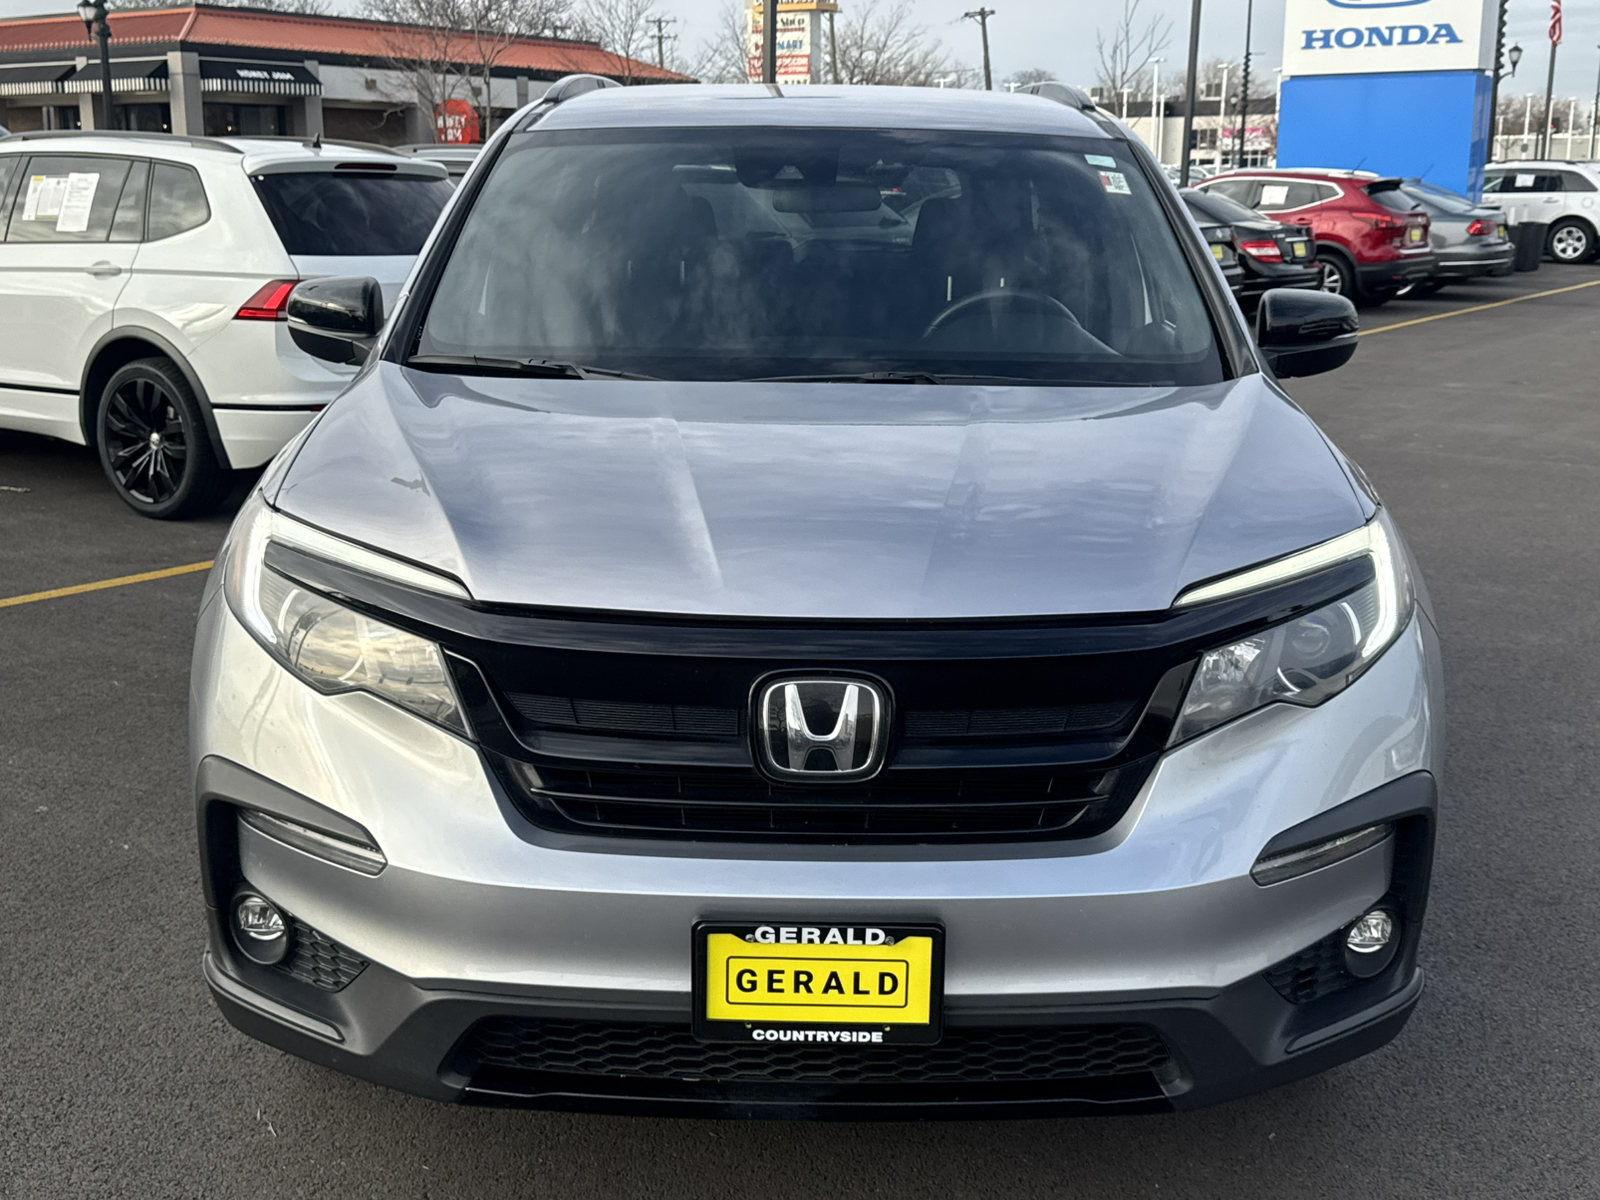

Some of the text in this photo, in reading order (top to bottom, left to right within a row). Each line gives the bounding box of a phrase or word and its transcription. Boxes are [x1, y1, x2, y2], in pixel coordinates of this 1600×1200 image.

[1301, 23, 1463, 50] HONDA
[754, 926, 886, 946] GERALD
[735, 968, 899, 996] GERALD
[751, 1028, 884, 1044] COUNTRYSIDE
